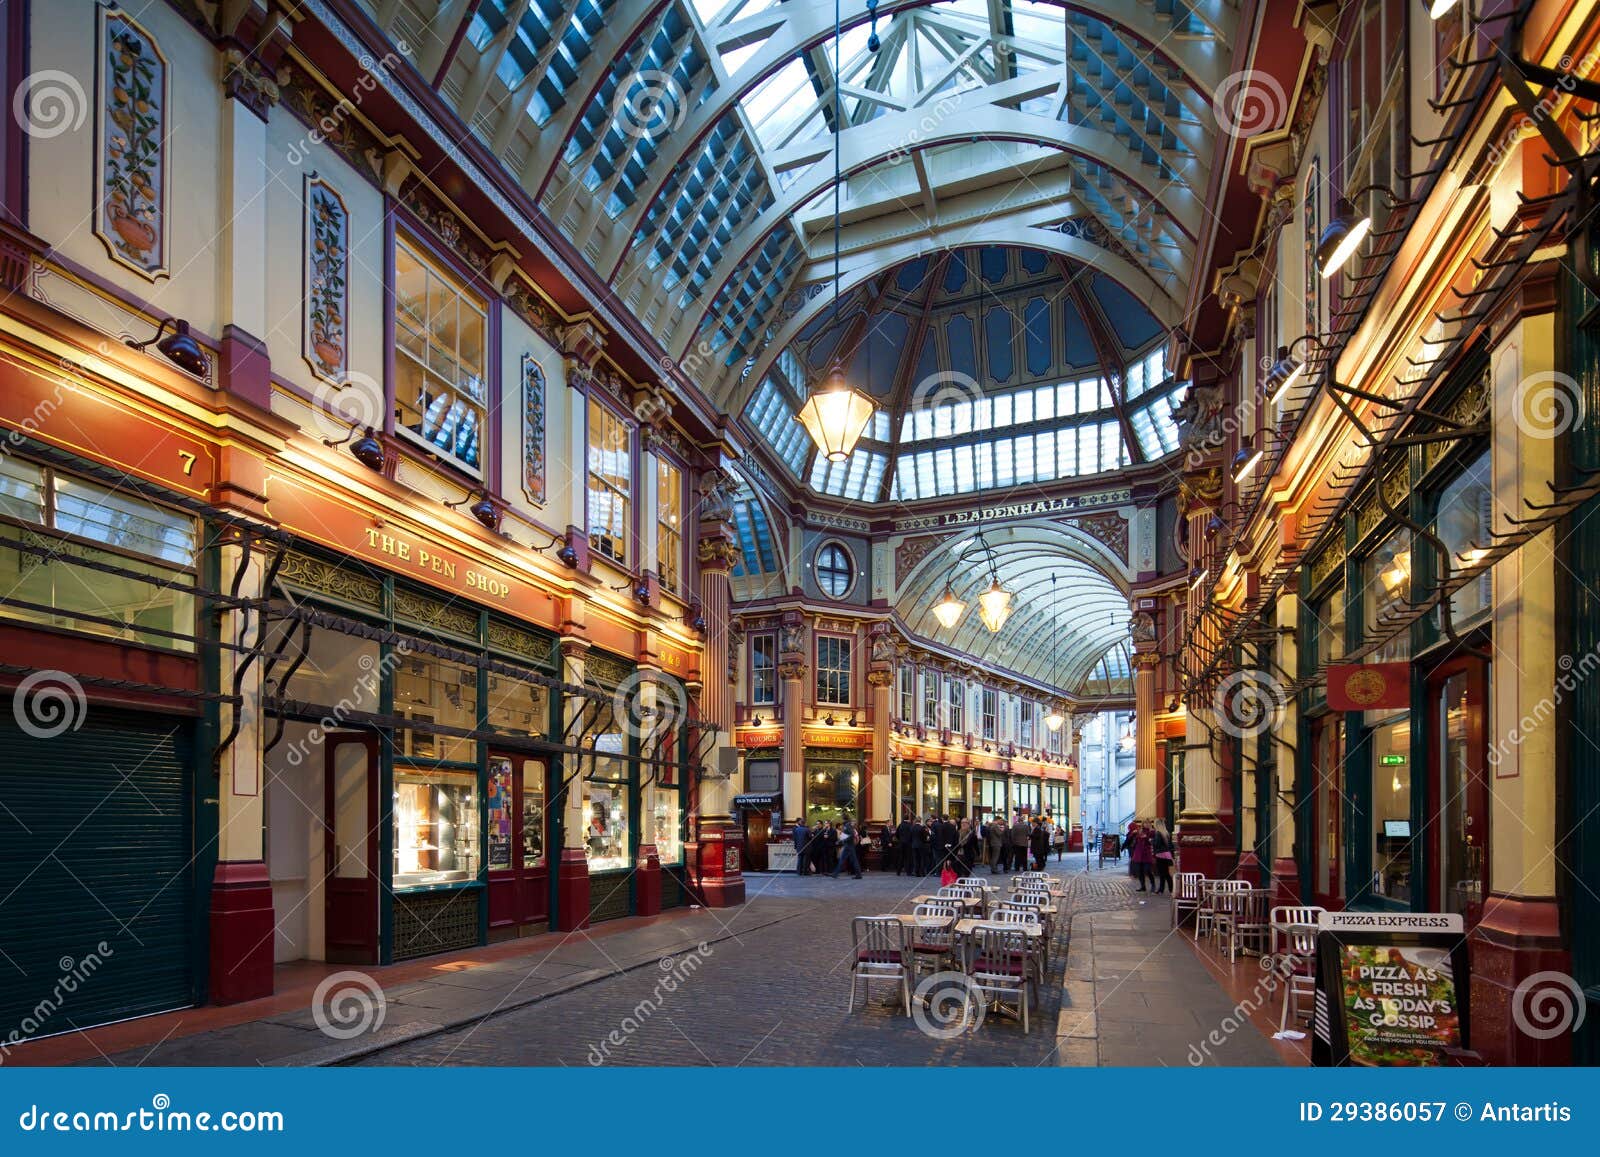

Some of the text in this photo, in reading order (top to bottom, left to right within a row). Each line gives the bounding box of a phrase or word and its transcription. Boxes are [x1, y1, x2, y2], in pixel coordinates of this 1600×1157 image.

[178, 449, 196, 476] 7
[944, 498, 1074, 524] LEADENHALL
[366, 528, 510, 598] THE PEN SHOP
[1332, 916, 1449, 928] PIZZA EXPRESS
[1360, 966, 1438, 981] PIZZA AS
[1372, 982, 1427, 996] FRESH
[1353, 997, 1451, 1014] AS TODAY'S
[1370, 1014, 1438, 1029] GOSSIP.
